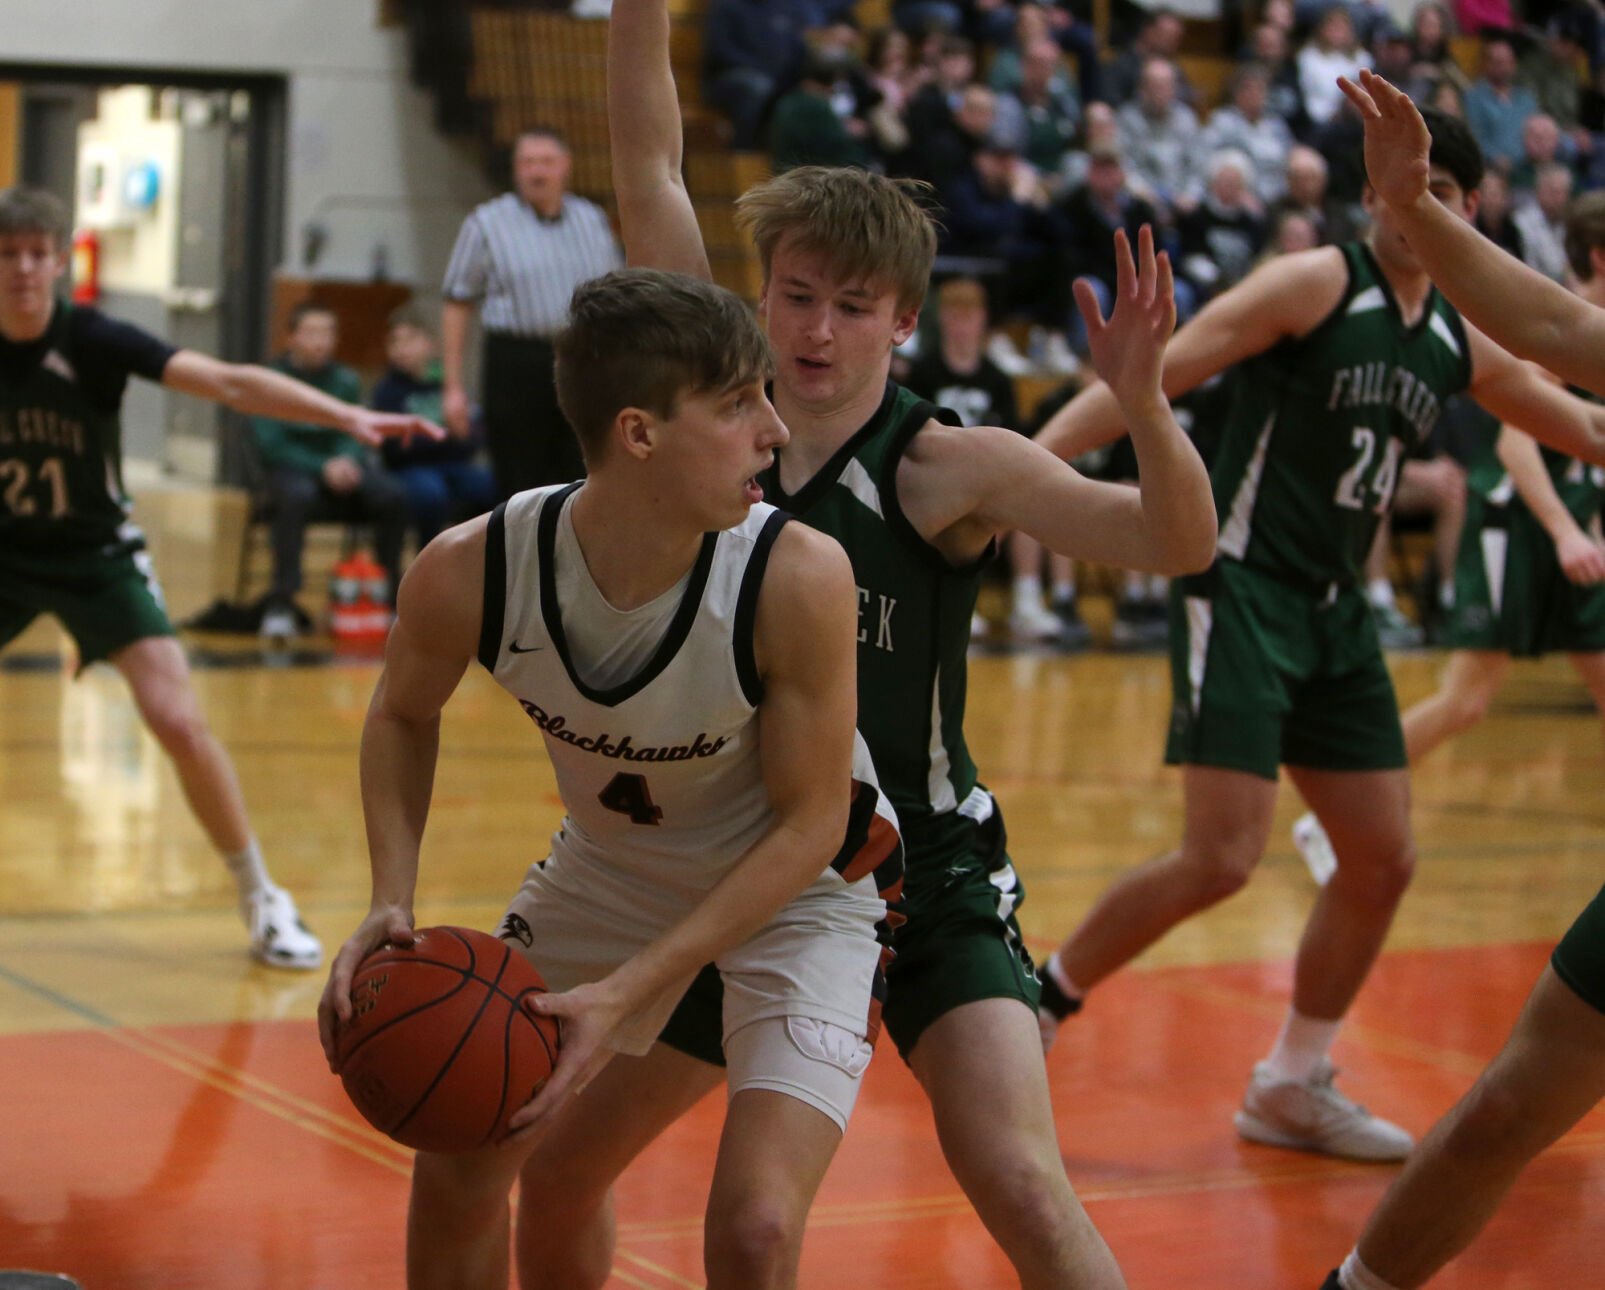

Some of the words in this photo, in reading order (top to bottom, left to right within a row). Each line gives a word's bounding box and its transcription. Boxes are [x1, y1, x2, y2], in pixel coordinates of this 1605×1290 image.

[1328, 361, 1386, 411] FALL
[0, 457, 69, 518] 21
[1334, 425, 1404, 514] 24
[518, 698, 732, 762] Blackhawks
[598, 771, 664, 827] 4
